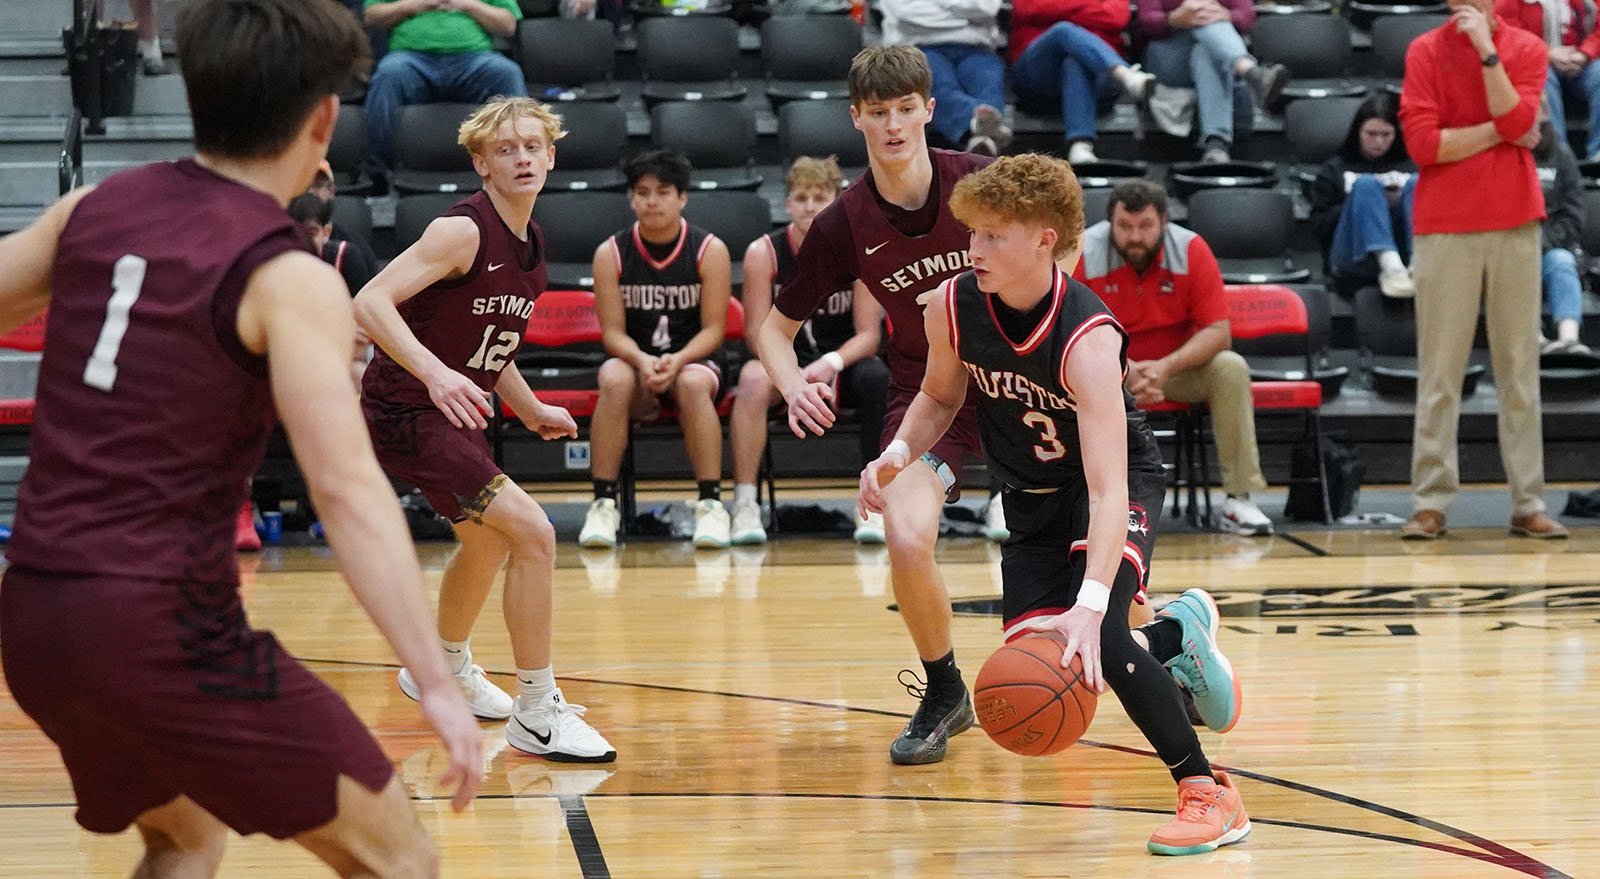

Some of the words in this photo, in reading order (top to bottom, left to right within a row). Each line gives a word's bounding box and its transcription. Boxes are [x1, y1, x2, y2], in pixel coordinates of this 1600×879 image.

[471, 294, 535, 321] SEYMO
[620, 283, 702, 311] HOUSTON
[83, 253, 148, 392] 1
[651, 314, 671, 351] 4
[466, 323, 521, 373] 12
[1022, 410, 1067, 462] 3
